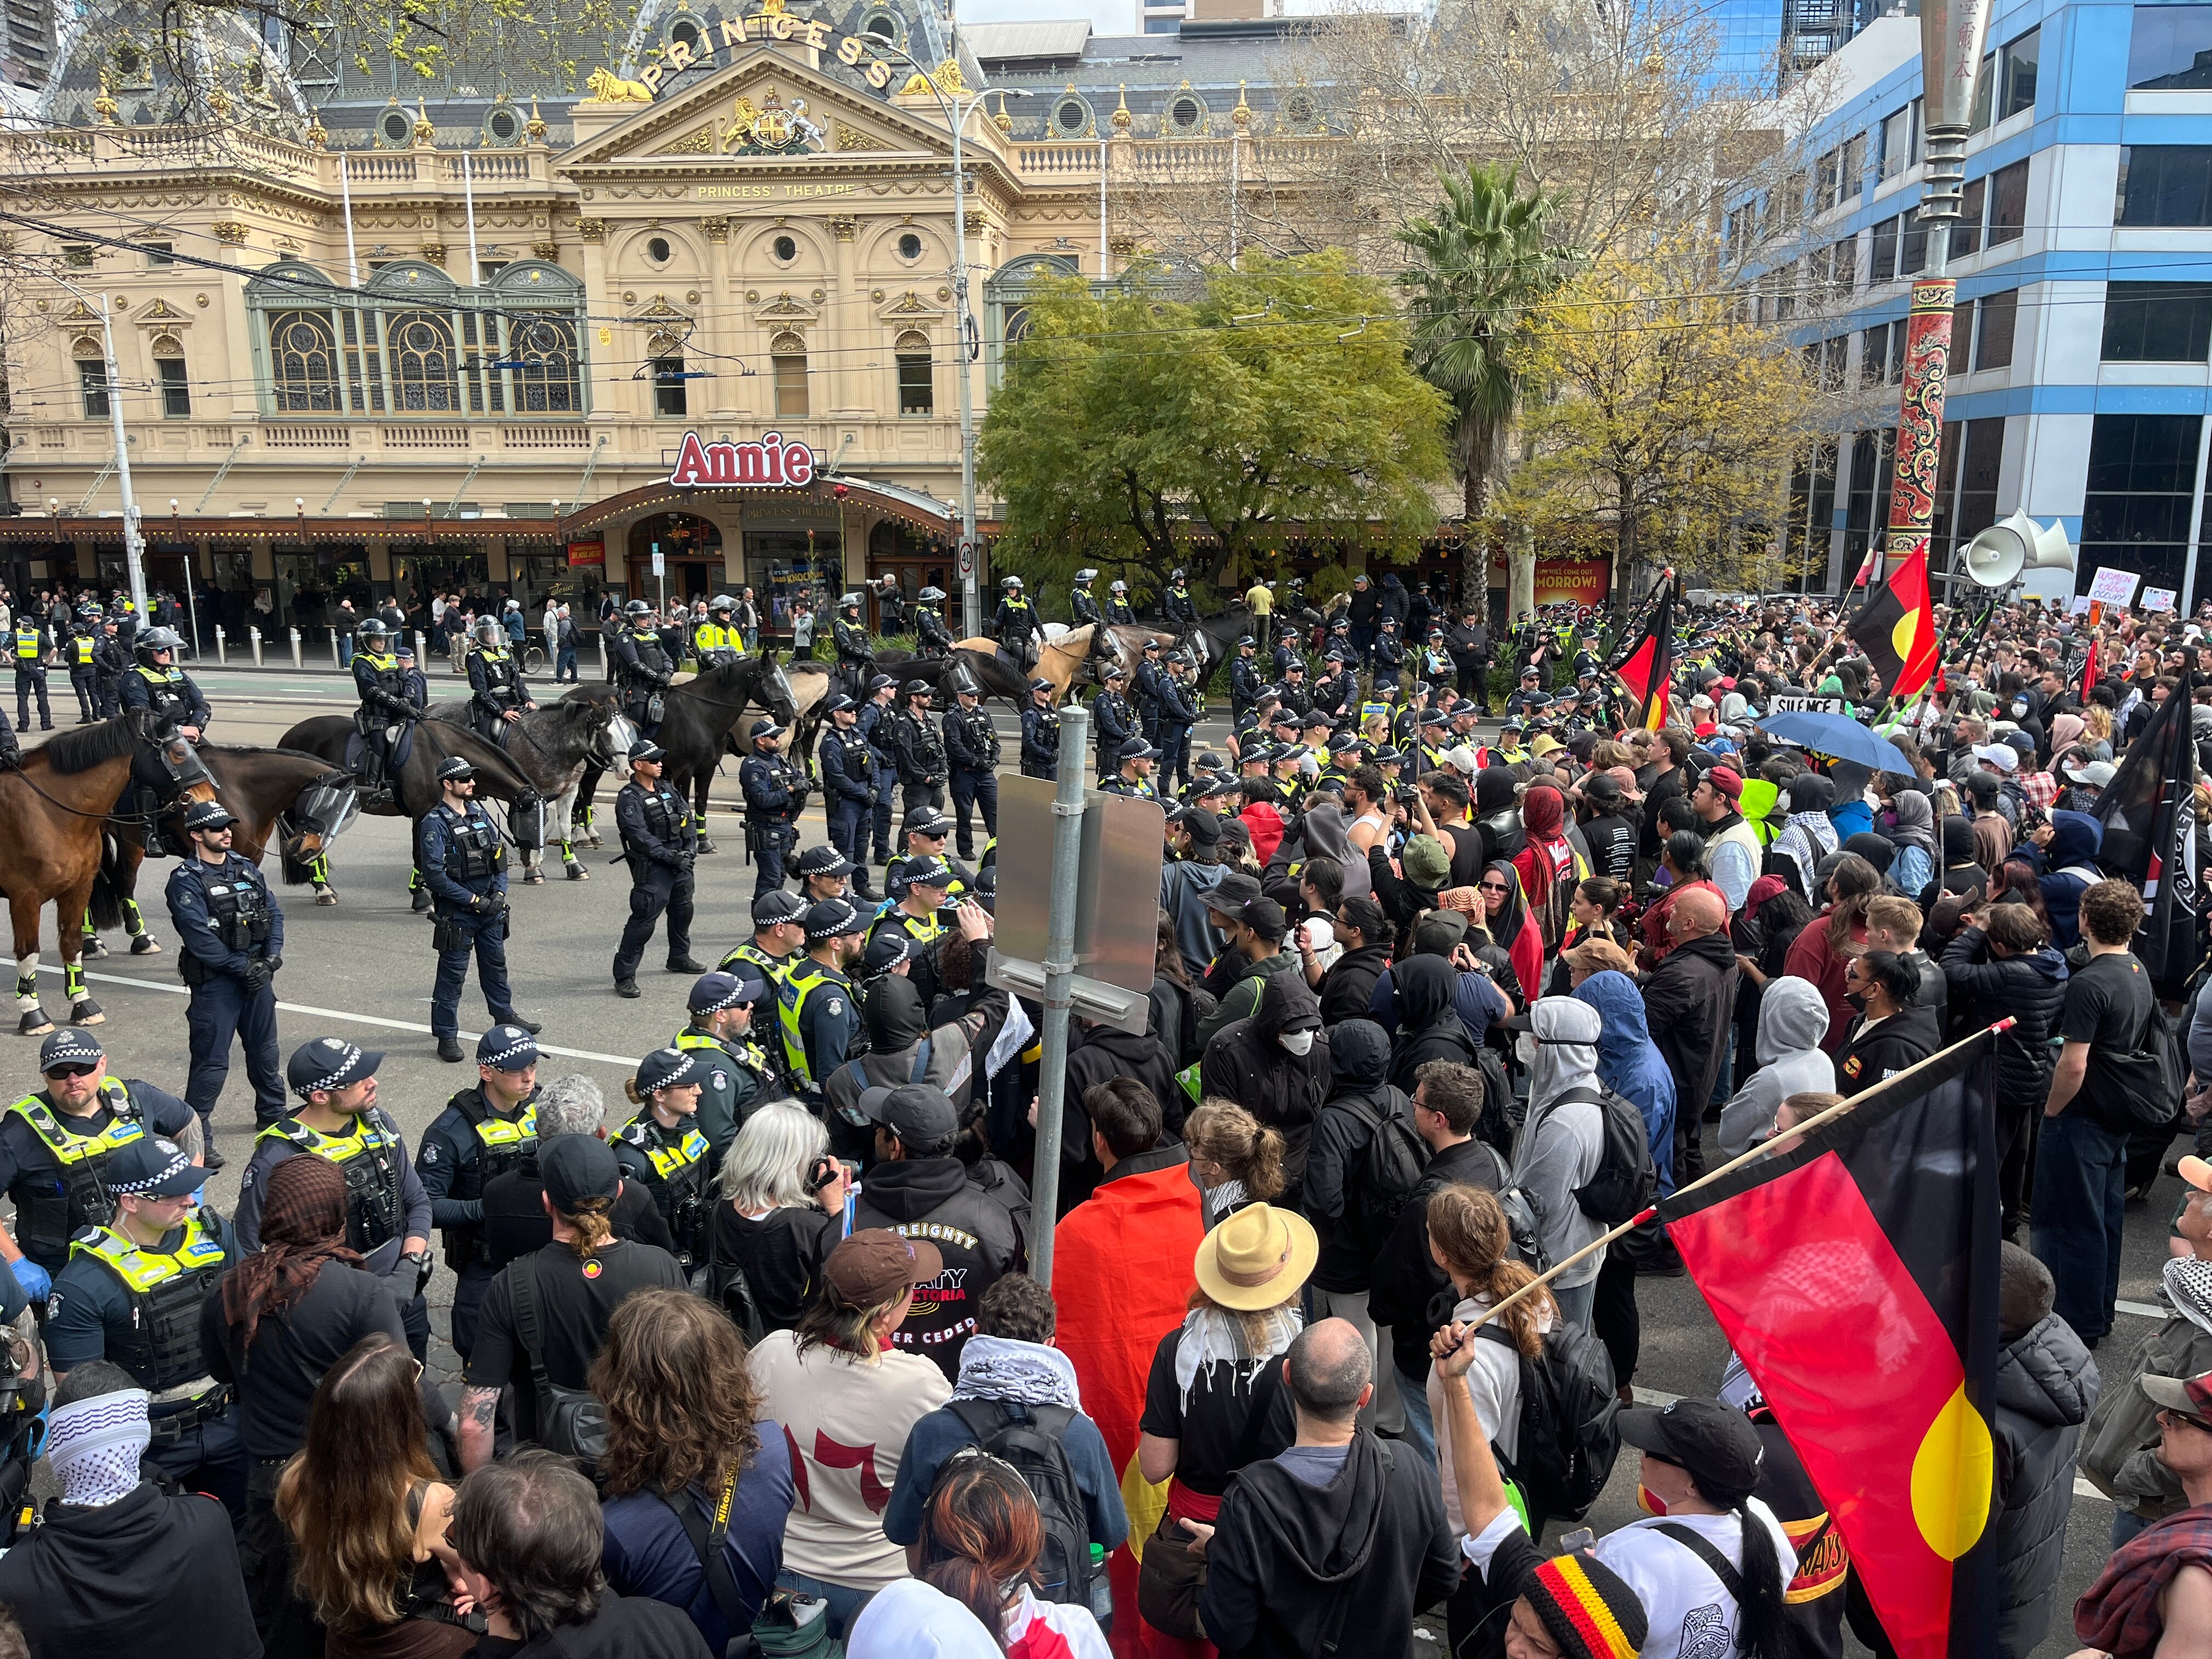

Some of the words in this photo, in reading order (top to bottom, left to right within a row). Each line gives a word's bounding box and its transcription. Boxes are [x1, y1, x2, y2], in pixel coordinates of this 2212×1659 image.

[640, 15, 892, 95] PRINCESS
[784, 184, 856, 197] THEATRE
[670, 432, 812, 486] Annie
[747, 507, 792, 519] PRINCESS
[797, 506, 837, 518] THEATRE
[962, 550, 971, 565] 40
[786, 571, 813, 584] KNOCK
[1534, 576, 1597, 588] MORROW!
[2097, 570, 2132, 583] WOMEN
[2098, 583, 2126, 594] COLOUR
[2094, 590, 2126, 601] OCCUPY
[1776, 698, 1831, 713] SILENCE
[114, 1126, 138, 1138] Police
[690, 1141, 706, 1155] Police
[886, 1223, 978, 1249] REIGNTY
[193, 1244, 219, 1254] Police
[893, 1330, 914, 1345] ER
[922, 1316, 976, 1344] CEDED
[718, 1488, 731, 1523] Nikon
